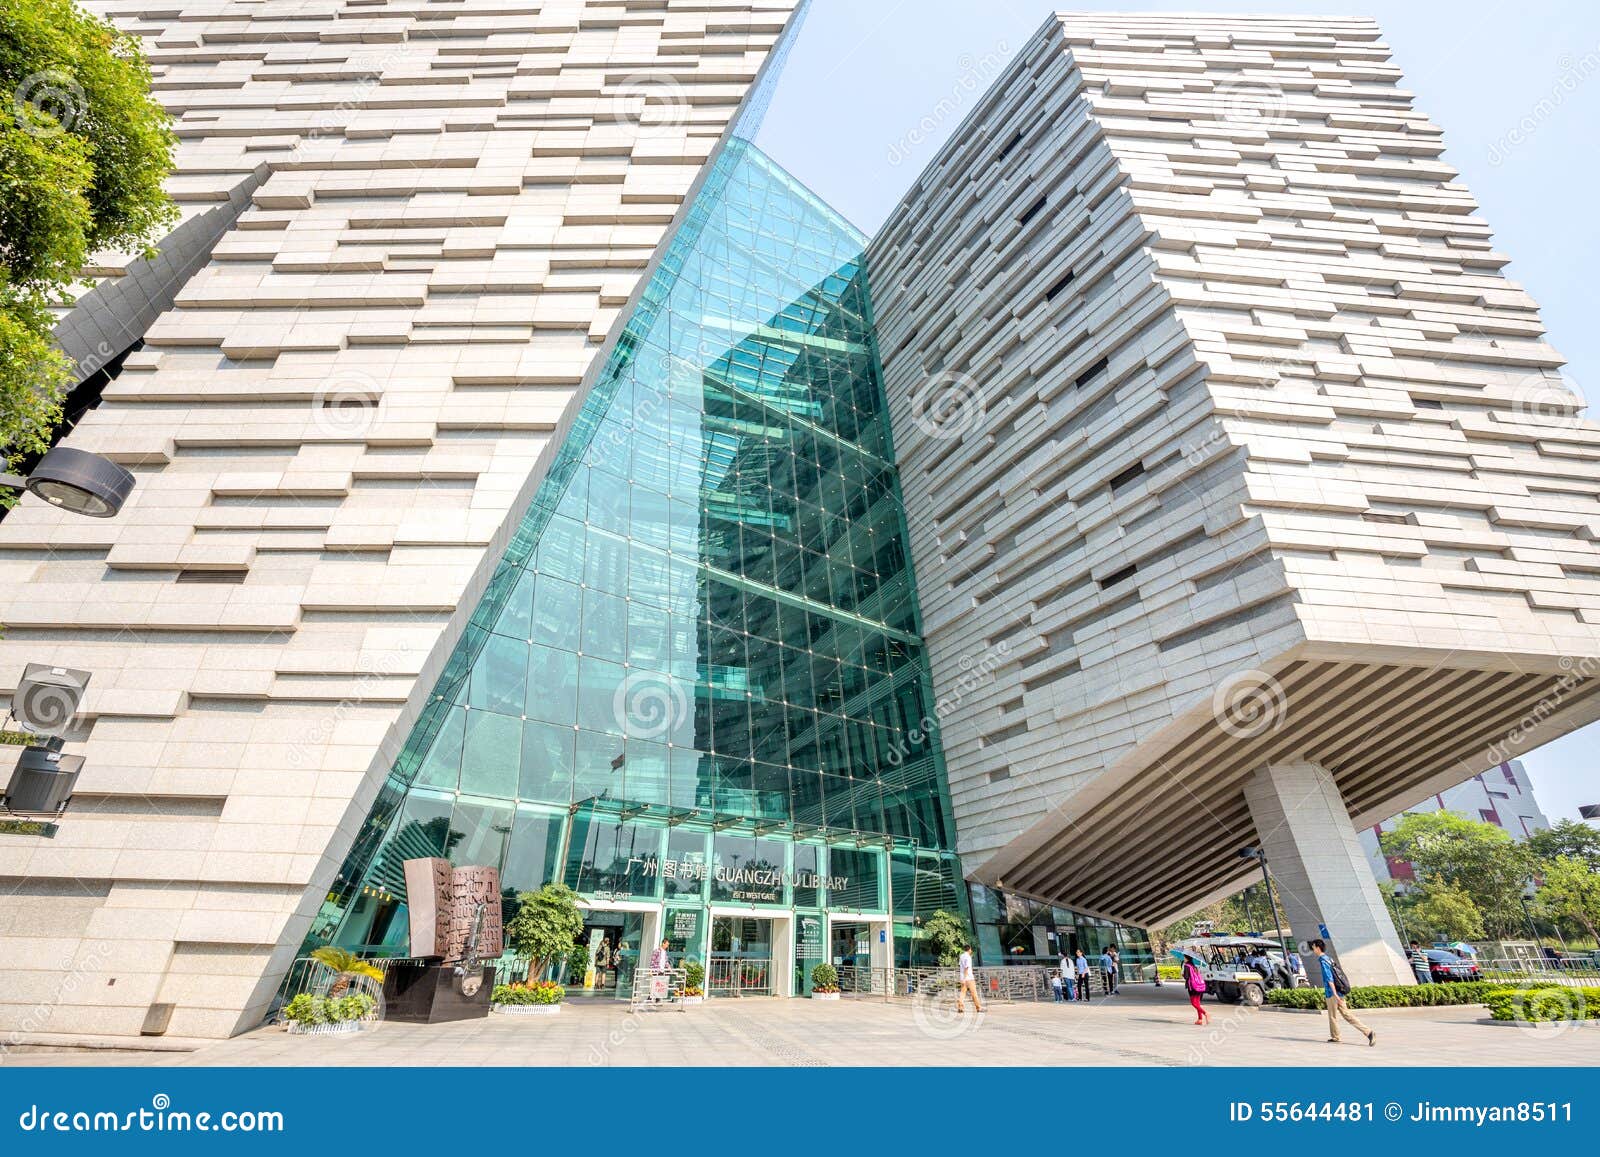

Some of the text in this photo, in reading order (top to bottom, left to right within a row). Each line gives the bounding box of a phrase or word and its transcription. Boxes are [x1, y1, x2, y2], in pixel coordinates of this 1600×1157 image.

[624, 857, 709, 880] 广州图书馆
[716, 867, 849, 891] GUANGZHOU LIBRARY
[615, 892, 633, 901] EXIT
[746, 892, 776, 901] WEST GATE
